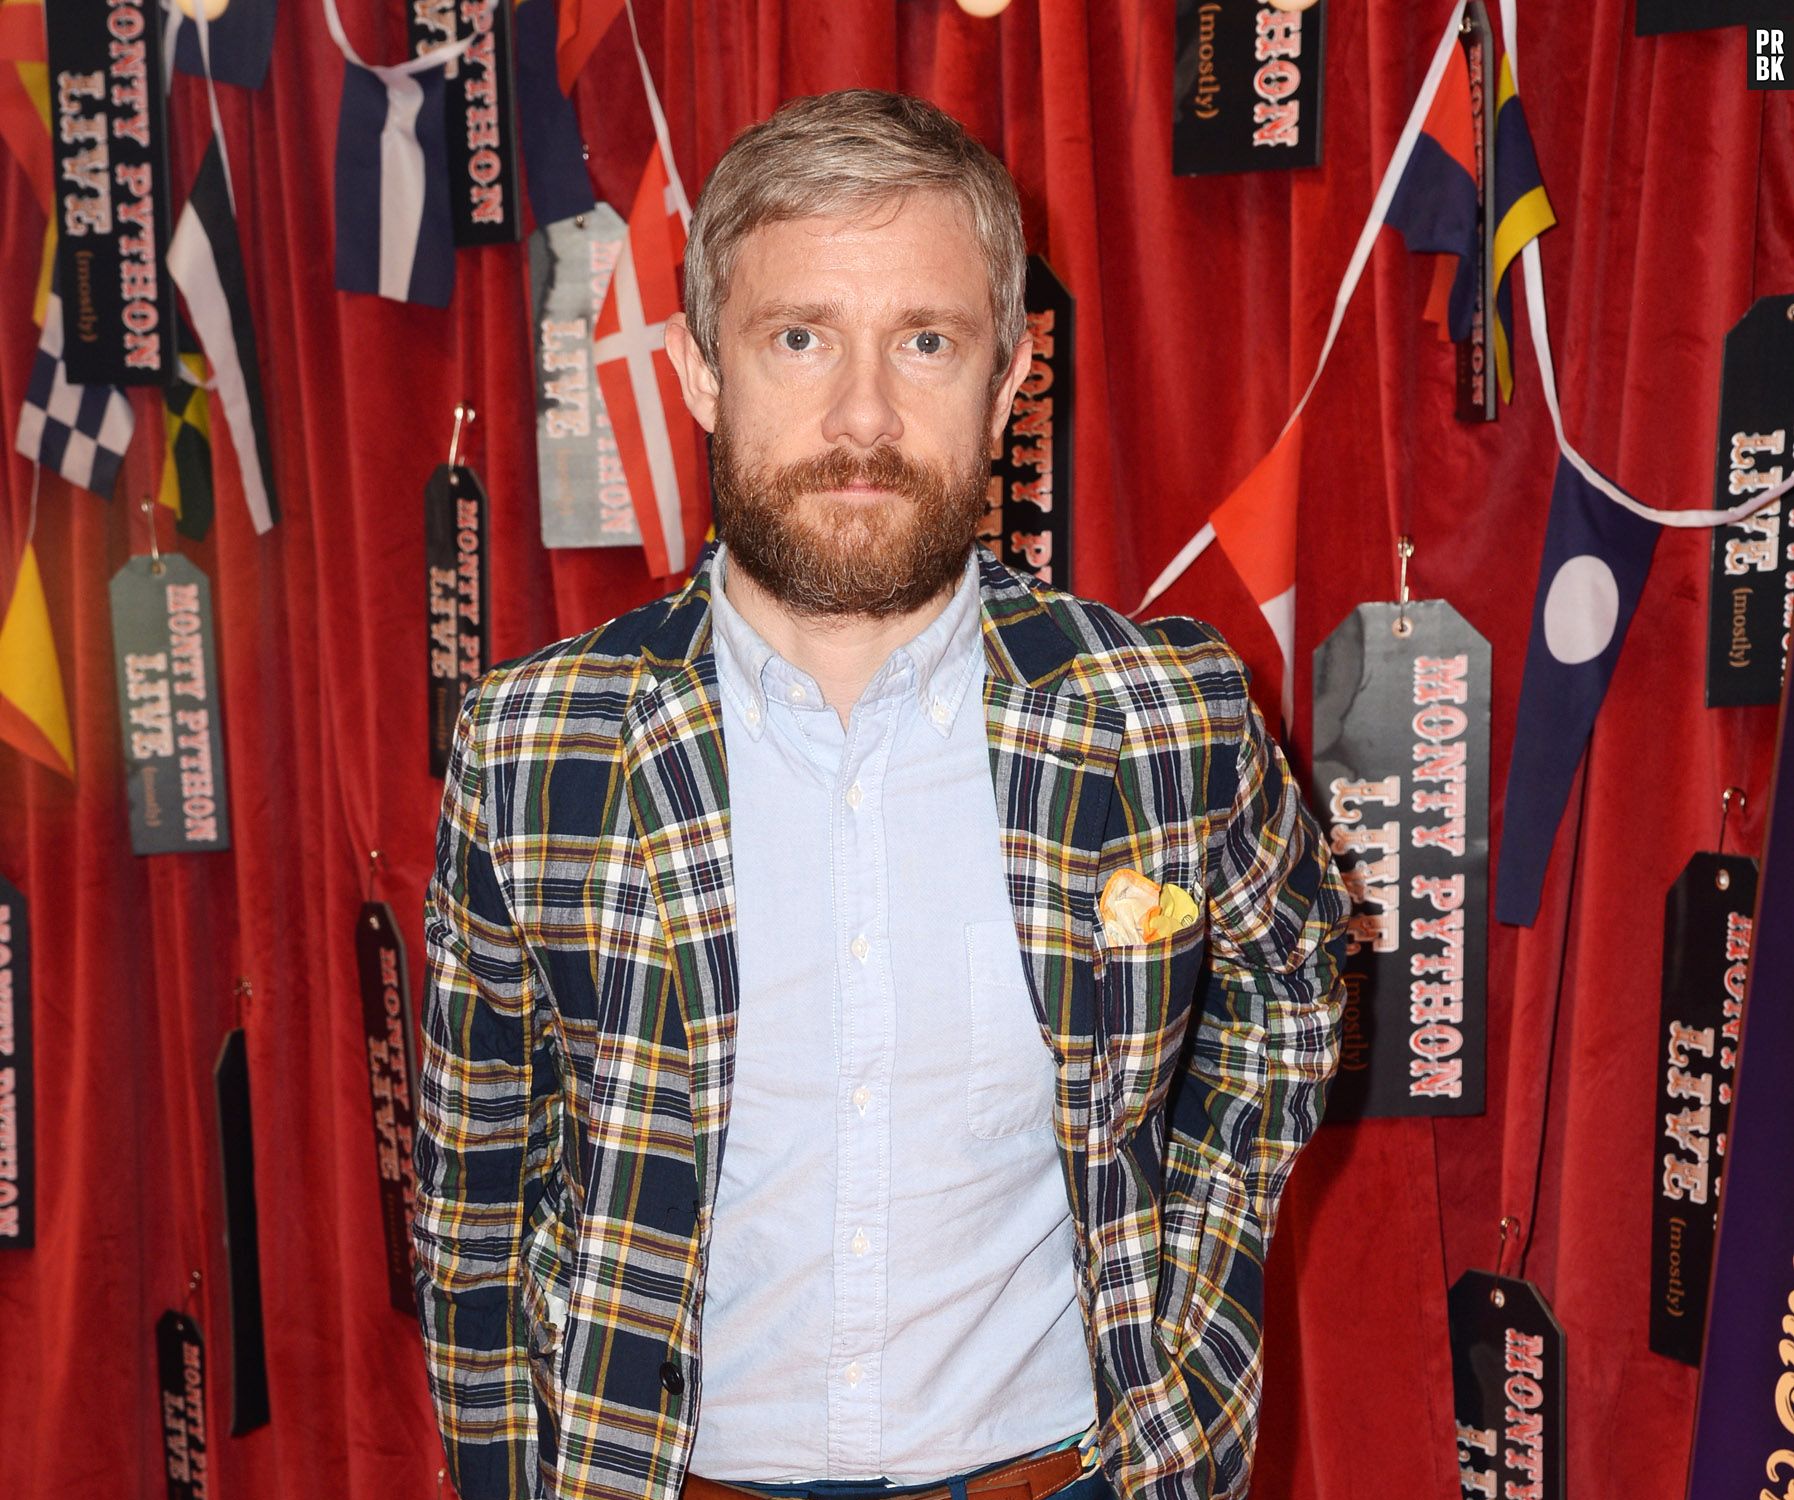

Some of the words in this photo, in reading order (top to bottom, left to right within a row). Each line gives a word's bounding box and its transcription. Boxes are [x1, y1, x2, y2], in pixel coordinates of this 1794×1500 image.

[106, 0, 151, 147] ONTY
[1195, 3, 1222, 119] (mostly)
[1253, 0, 1302, 147] HON
[57, 71, 113, 236] LIVE
[115, 163, 161, 371] PYTHON
[541, 318, 592, 439] LIVE
[430, 565, 457, 679] LIVE
[456, 498, 480, 625] MONTY
[165, 583, 207, 700] MONTY
[1728, 587, 1754, 668] (mostly)
[124, 653, 174, 759] LIVE
[1412, 654, 1469, 857] MONTY
[175, 709, 218, 841] PYTHON
[1329, 775, 1400, 952] LIVE
[379, 946, 411, 1112] MONTY
[1342, 972, 1369, 1071] (mostly)
[1409, 874, 1465, 1098] PYTHON
[369, 1036, 400, 1181] LIVE
[1663, 1020, 1715, 1204] LIVE
[1666, 1216, 1687, 1317] (mostly)
[163, 1391, 191, 1483] LIVE
[182, 1341, 206, 1444] MONTY
